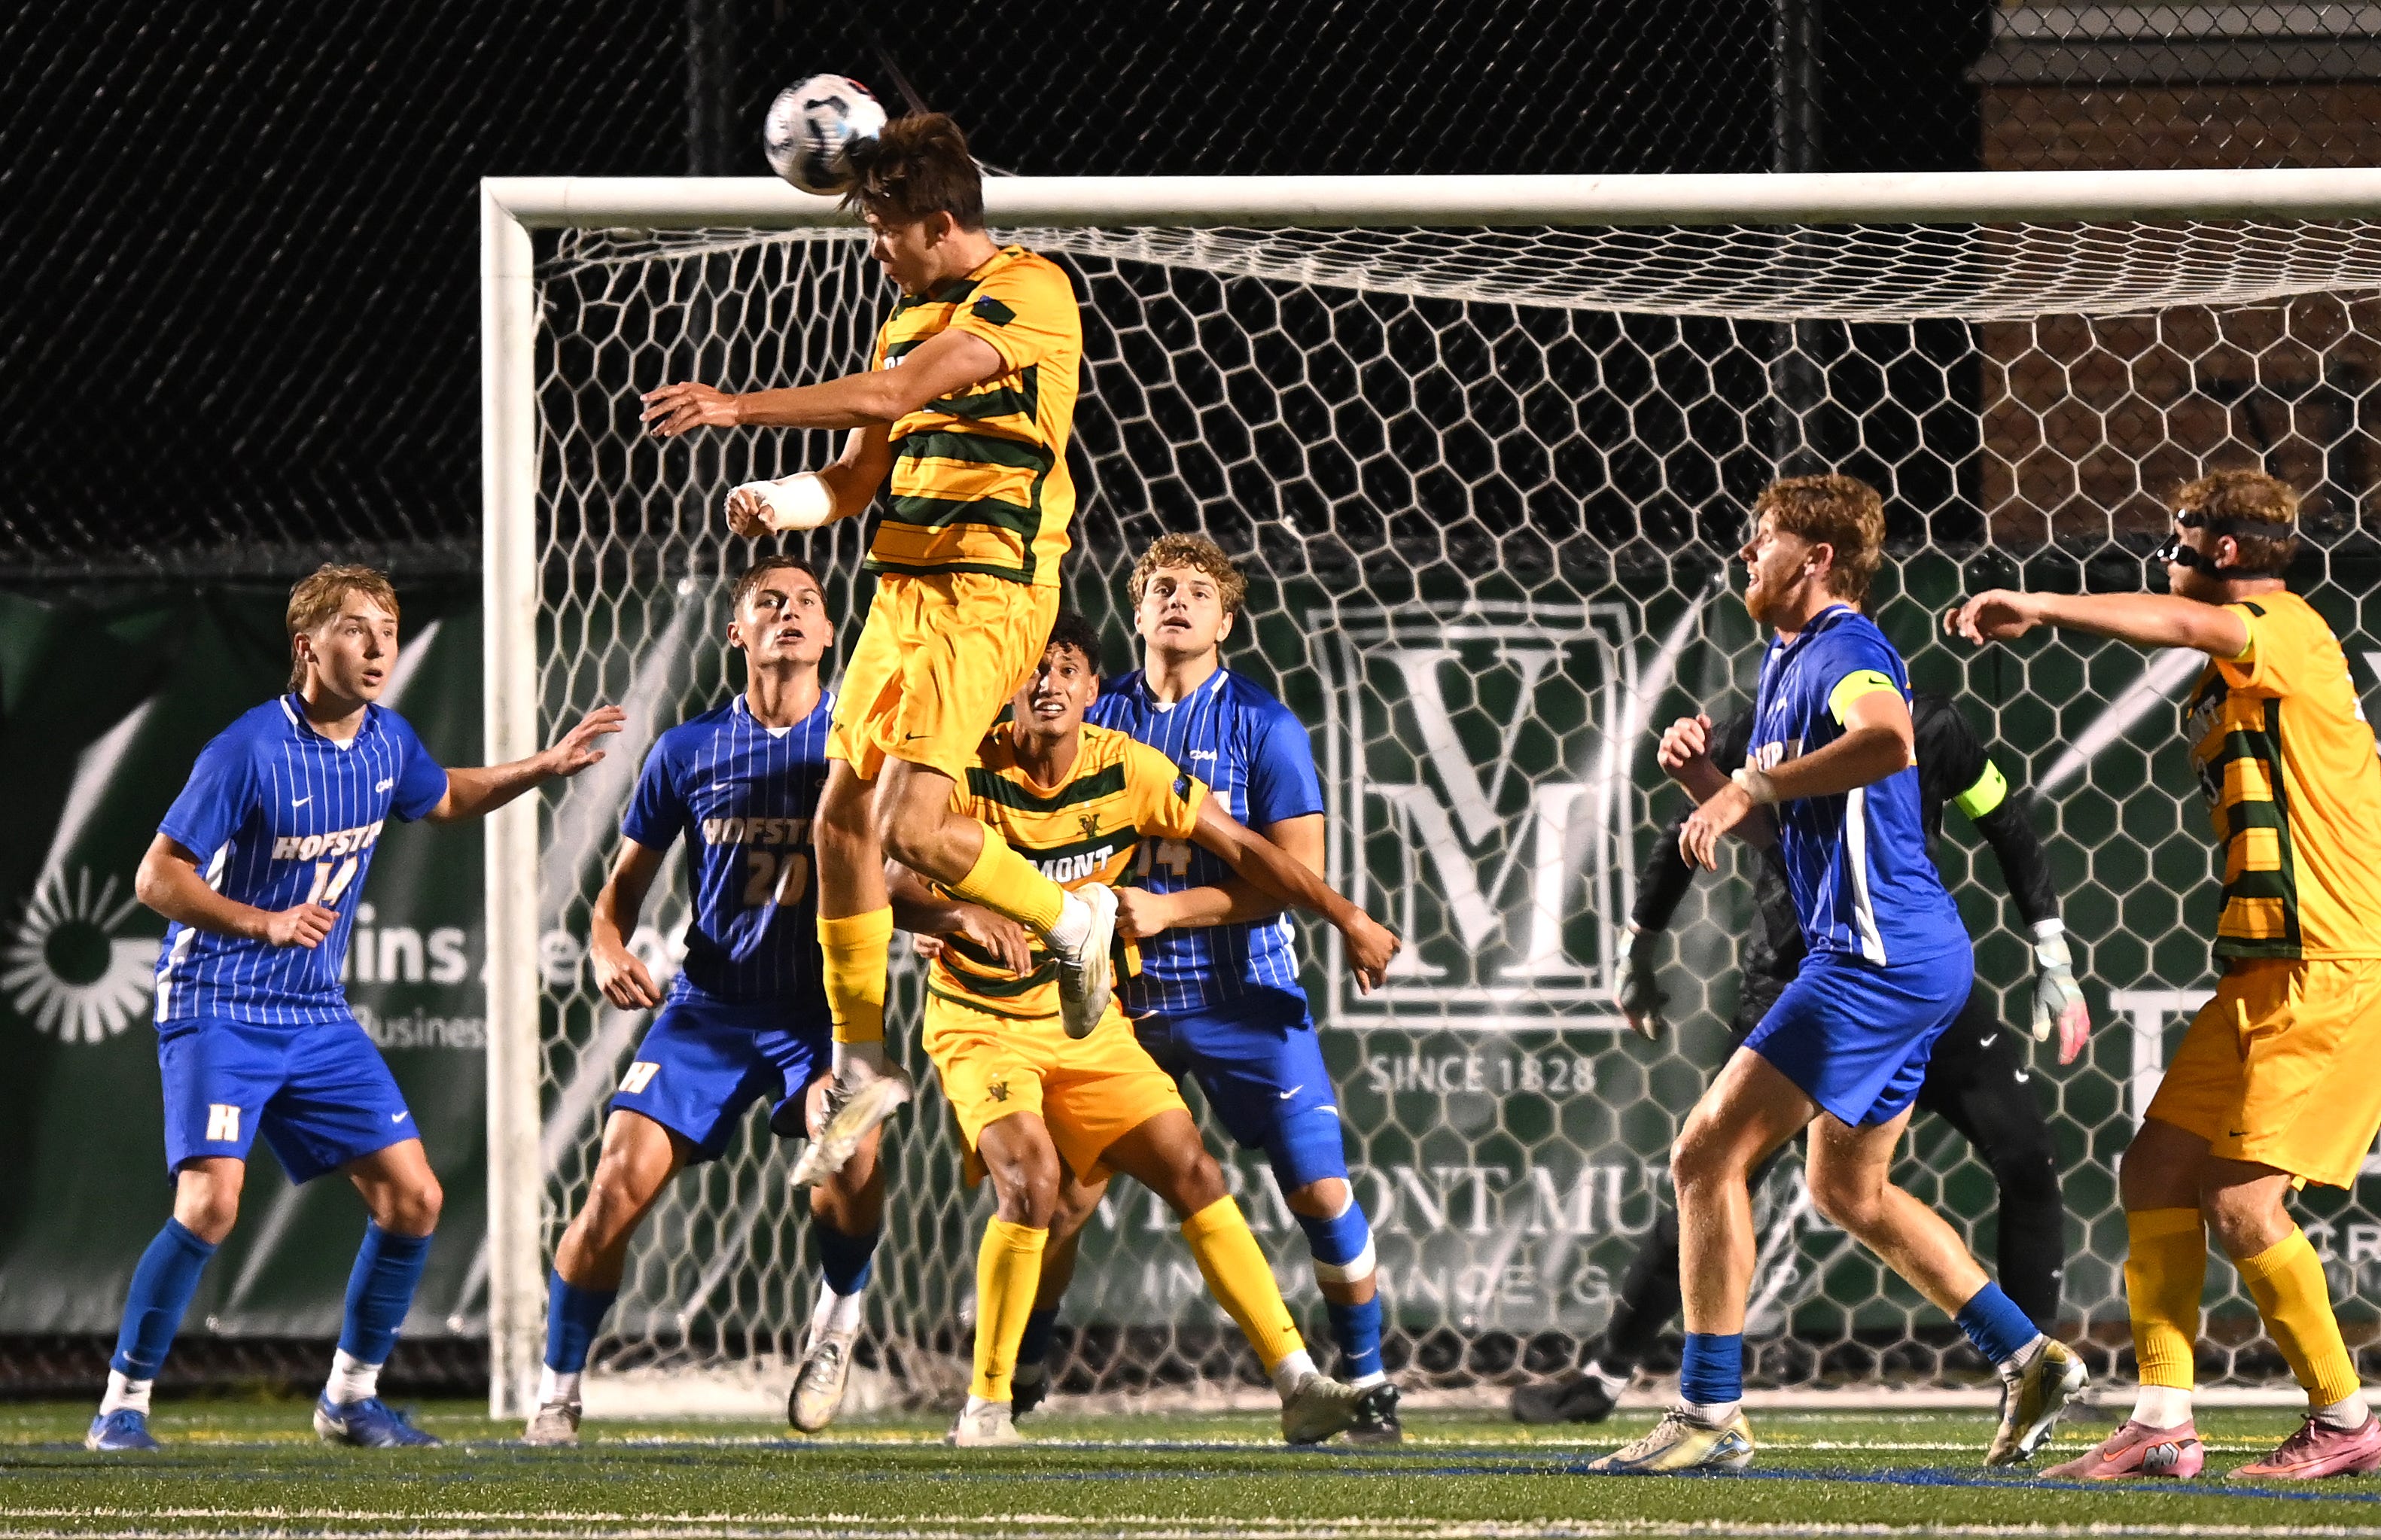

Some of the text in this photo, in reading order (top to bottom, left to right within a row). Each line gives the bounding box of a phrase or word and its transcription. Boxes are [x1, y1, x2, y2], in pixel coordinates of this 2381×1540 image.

[1364, 649, 1571, 847] V
[702, 817, 815, 845] HOFST
[743, 851, 808, 906] 20
[1028, 845, 1113, 884] MONT
[340, 902, 468, 983] ins
[617, 1061, 662, 1094] H
[1368, 1054, 1597, 1092] SINCE 1828
[205, 1103, 242, 1143] H
